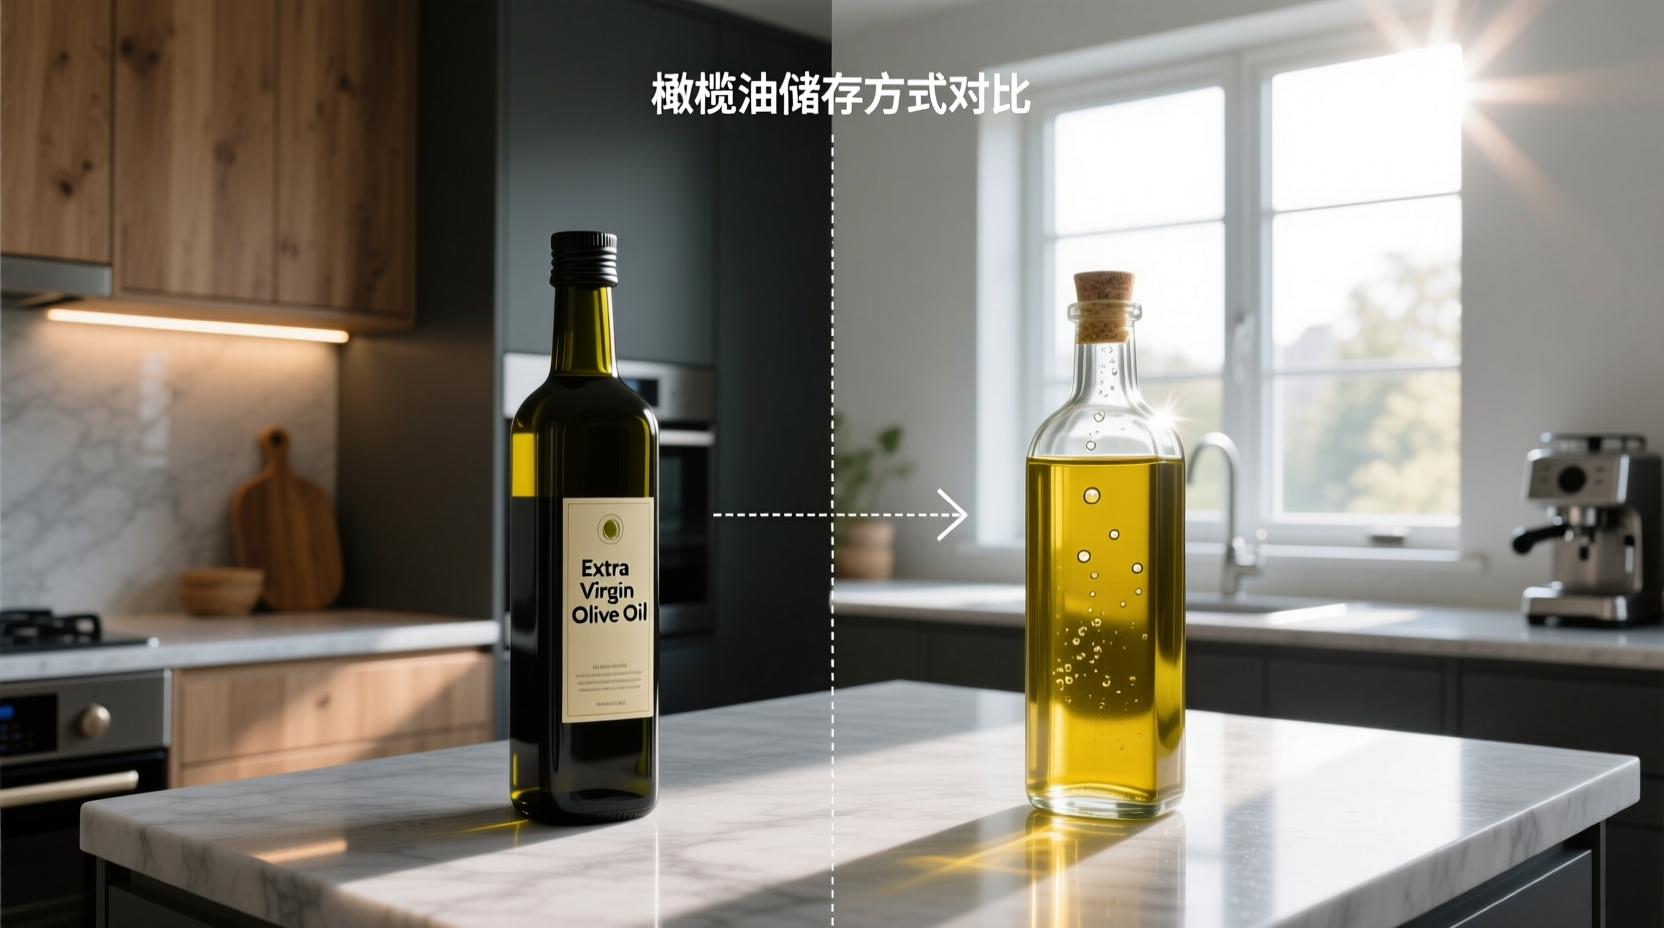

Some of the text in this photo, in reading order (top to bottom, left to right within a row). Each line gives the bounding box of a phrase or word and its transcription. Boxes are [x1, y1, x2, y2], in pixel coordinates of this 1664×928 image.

[581, 559, 629, 577] Extra
[580, 581, 634, 604] Virgin
[572, 602, 647, 624] Olive Oil
